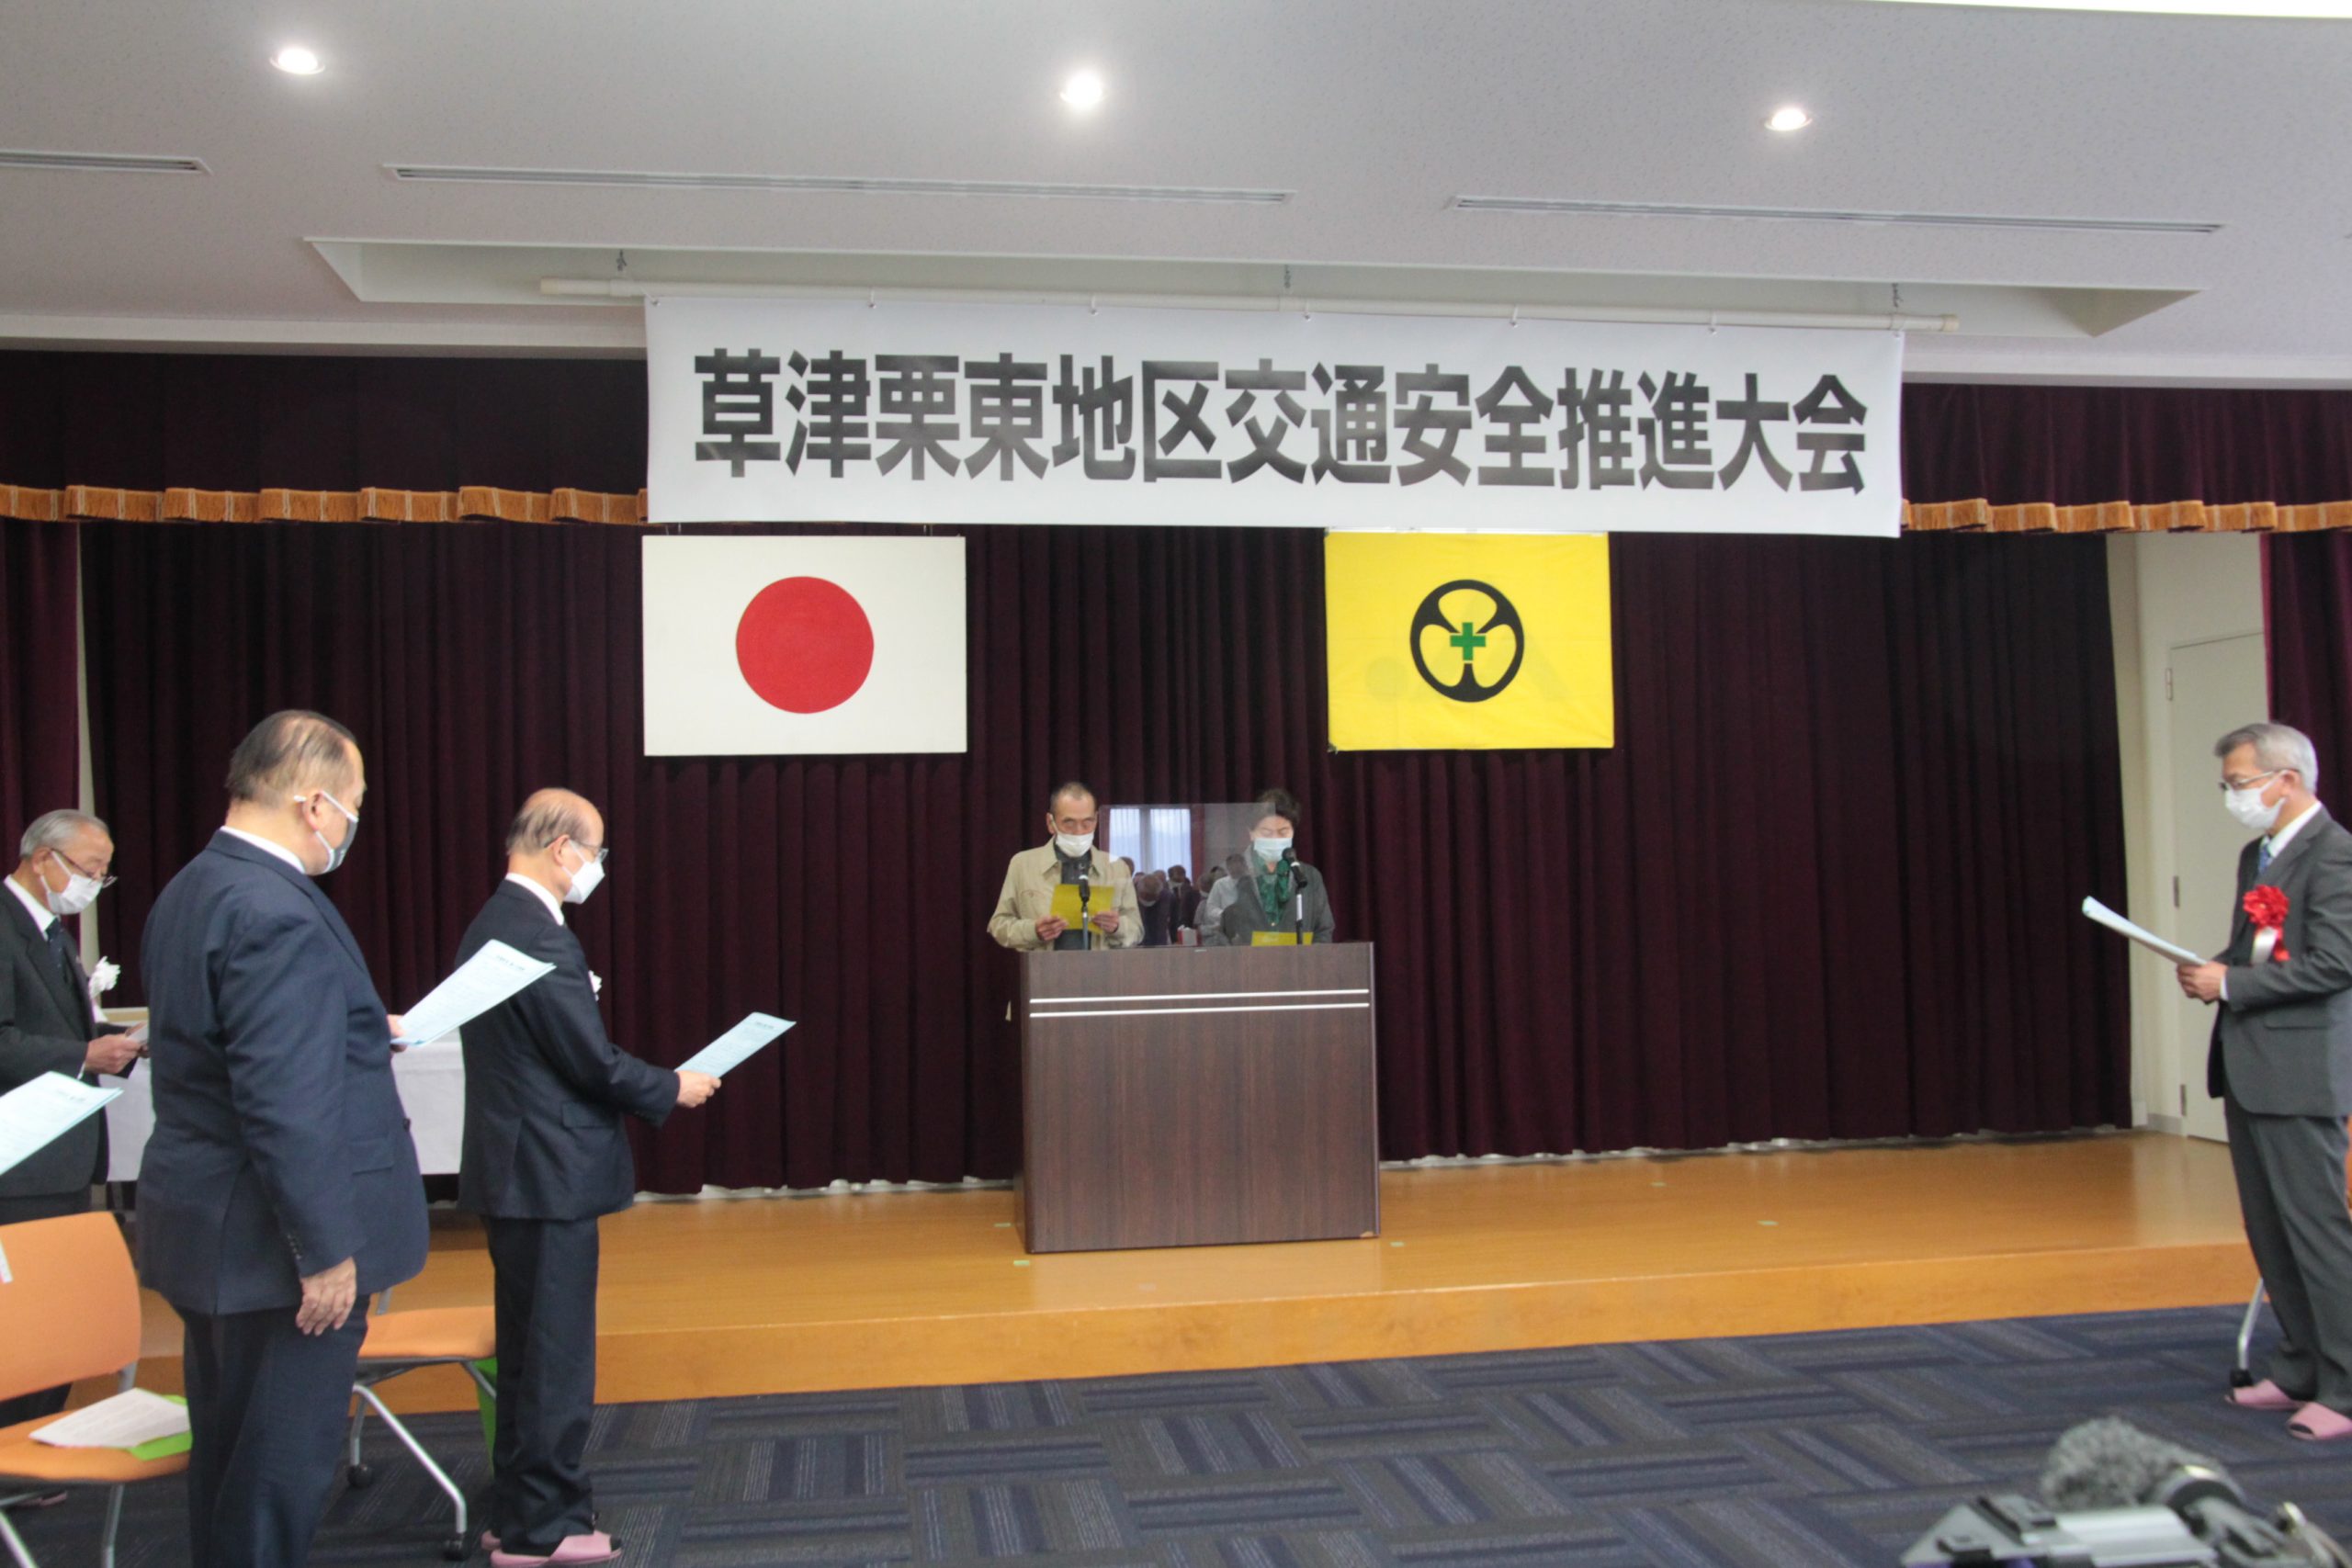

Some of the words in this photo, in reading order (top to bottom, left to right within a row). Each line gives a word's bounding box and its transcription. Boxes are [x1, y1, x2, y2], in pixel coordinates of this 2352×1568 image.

[694, 347, 1868, 495] 草津栗東地区交通安全推進大会
